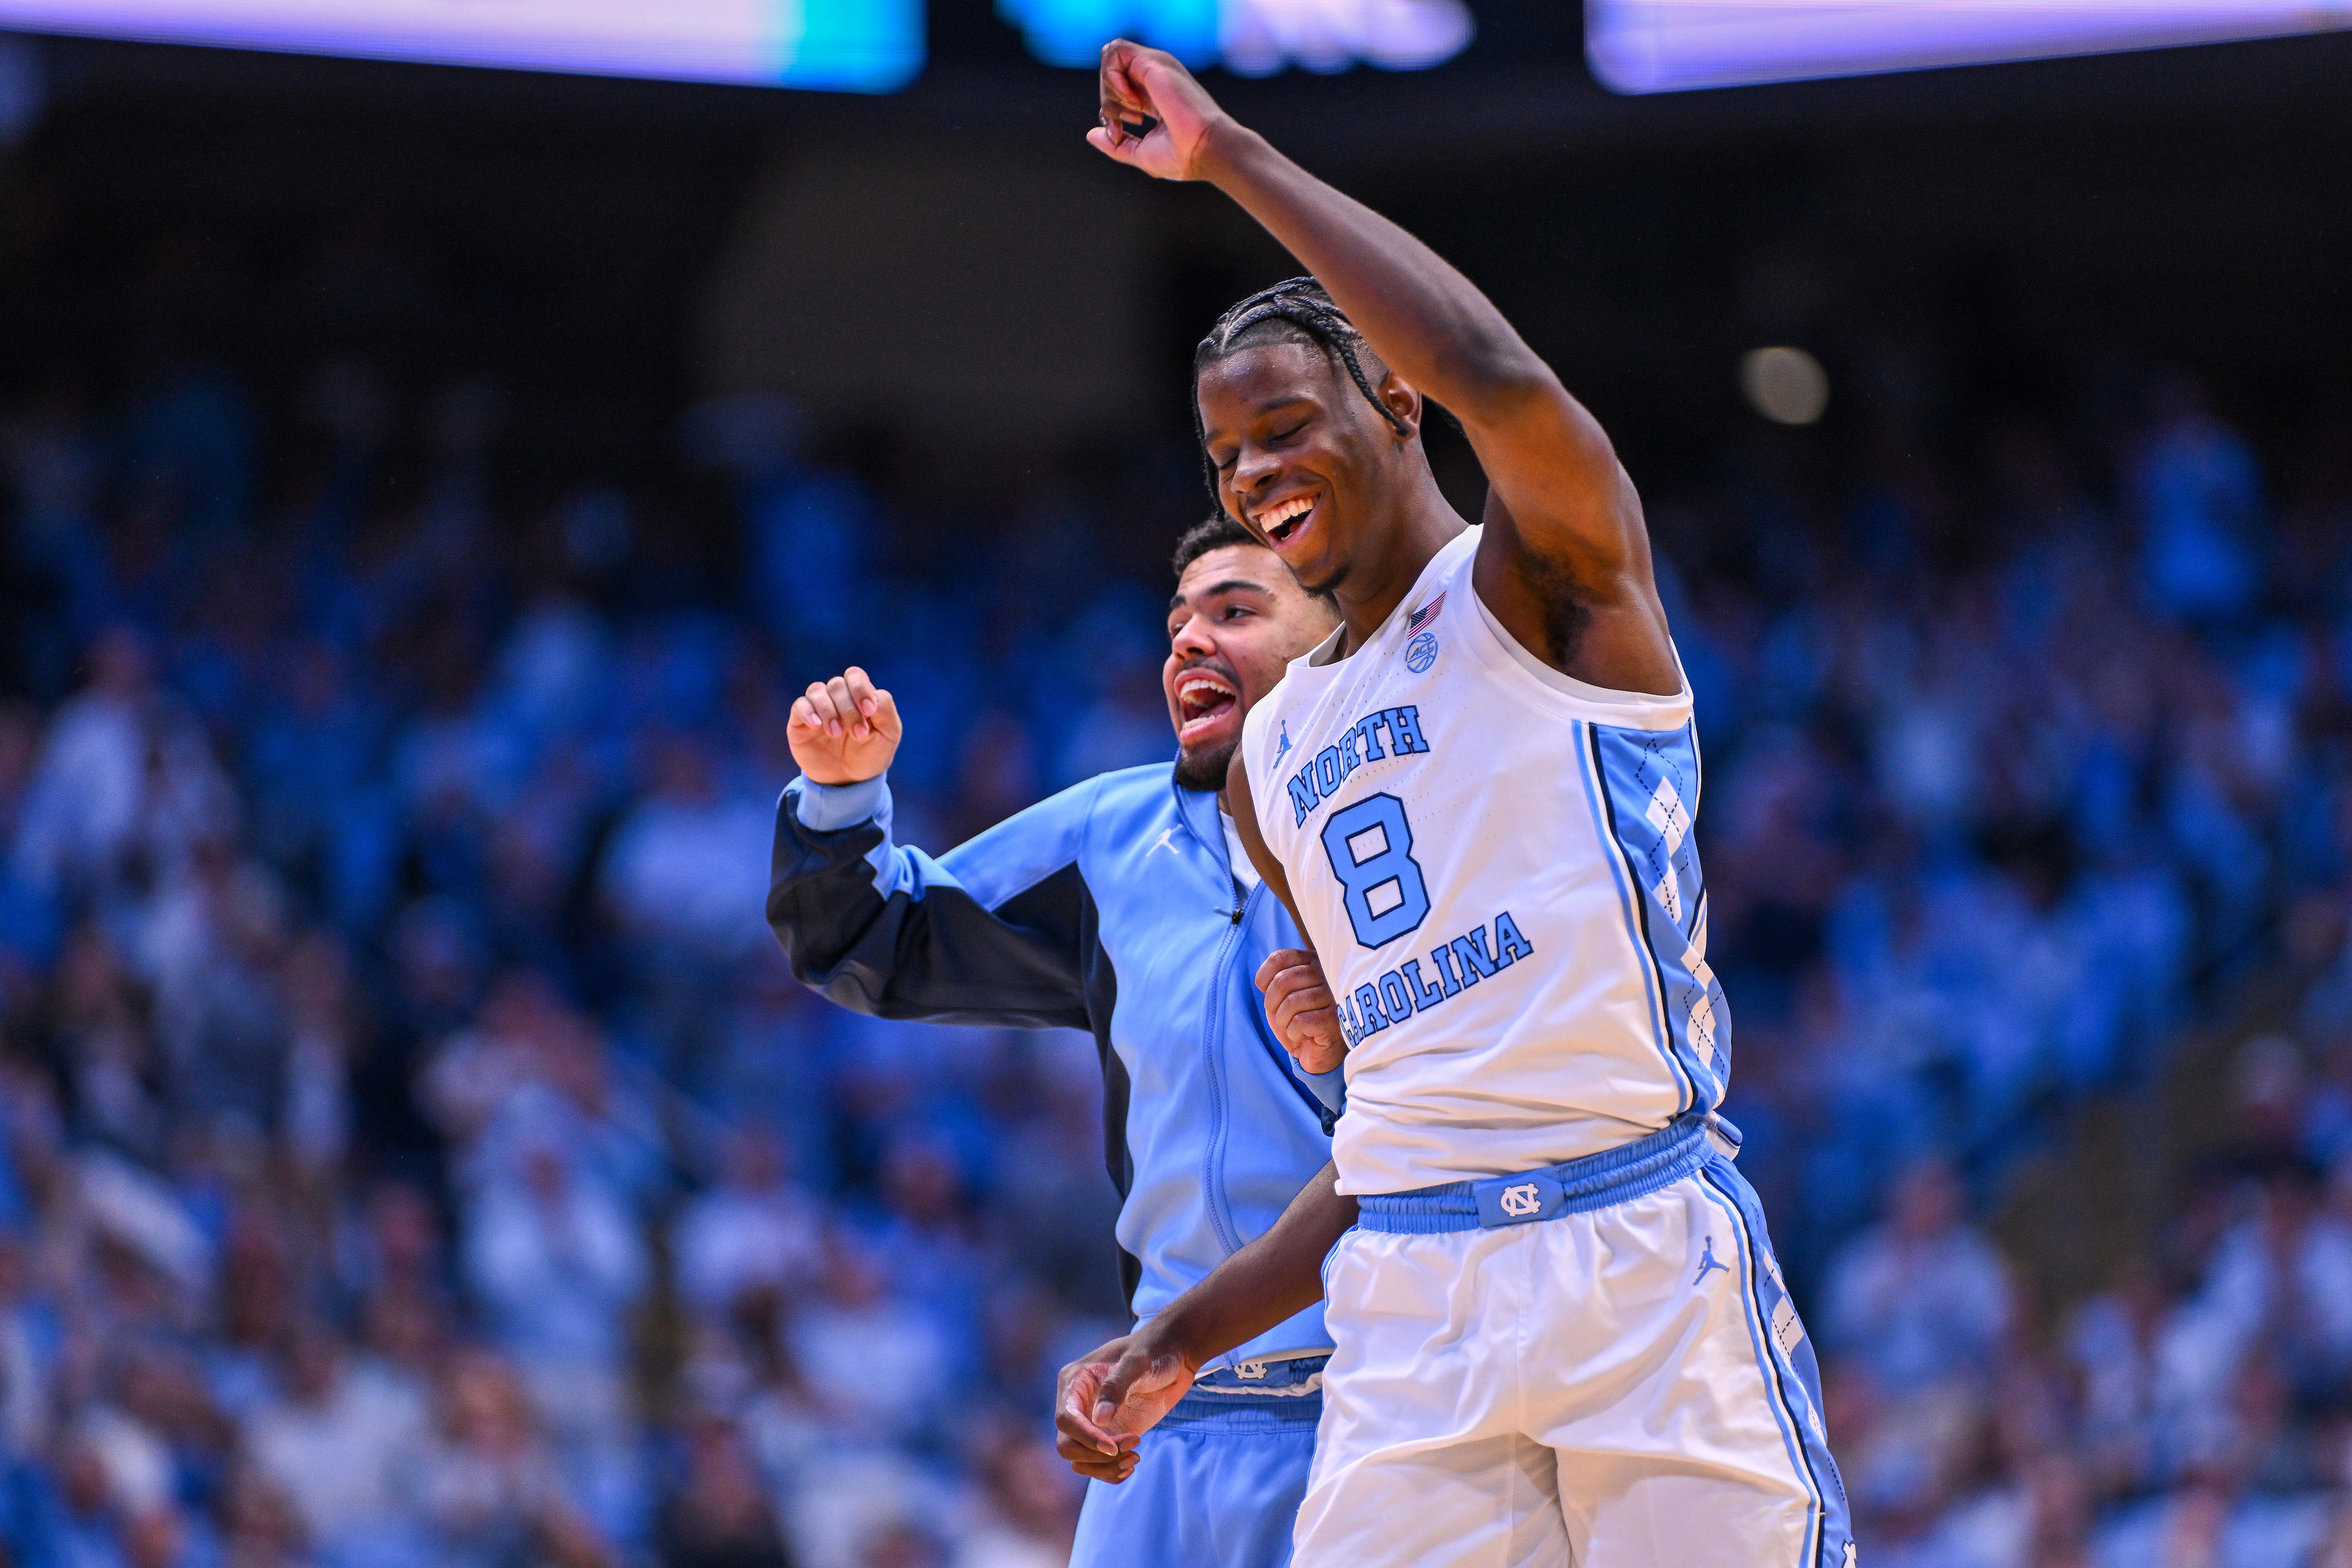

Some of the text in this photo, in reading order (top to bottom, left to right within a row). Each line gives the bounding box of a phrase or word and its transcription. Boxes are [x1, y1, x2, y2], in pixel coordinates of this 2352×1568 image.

[1410, 639, 1435, 659] ACC
[1287, 705, 1430, 828] NORTH
[1321, 792, 1431, 950] 8
[1337, 911, 1534, 1048] CAROLINA
